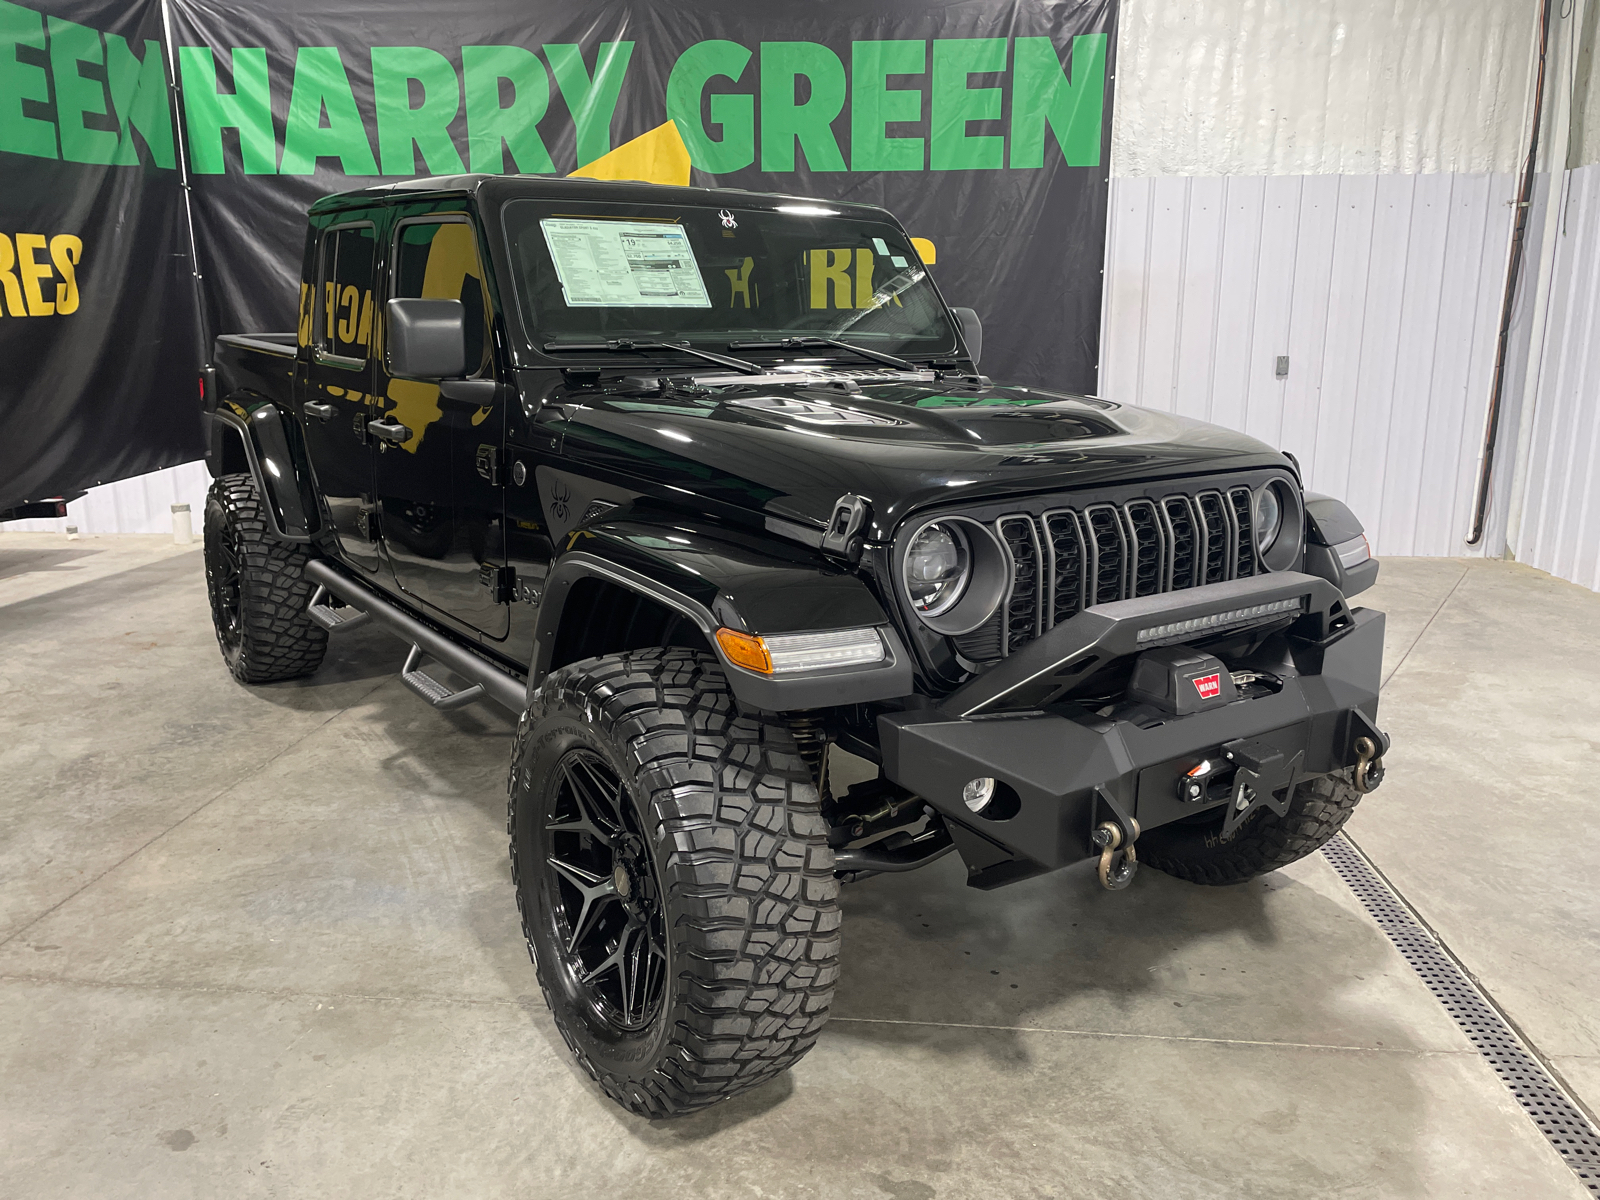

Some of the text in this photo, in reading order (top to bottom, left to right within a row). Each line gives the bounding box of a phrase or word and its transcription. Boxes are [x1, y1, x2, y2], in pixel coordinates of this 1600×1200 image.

[0, 0, 176, 170] EEN
[179, 33, 1108, 176] HARRY GREEN
[0, 232, 83, 317] RES
[1198, 681, 1218, 692] WARN
